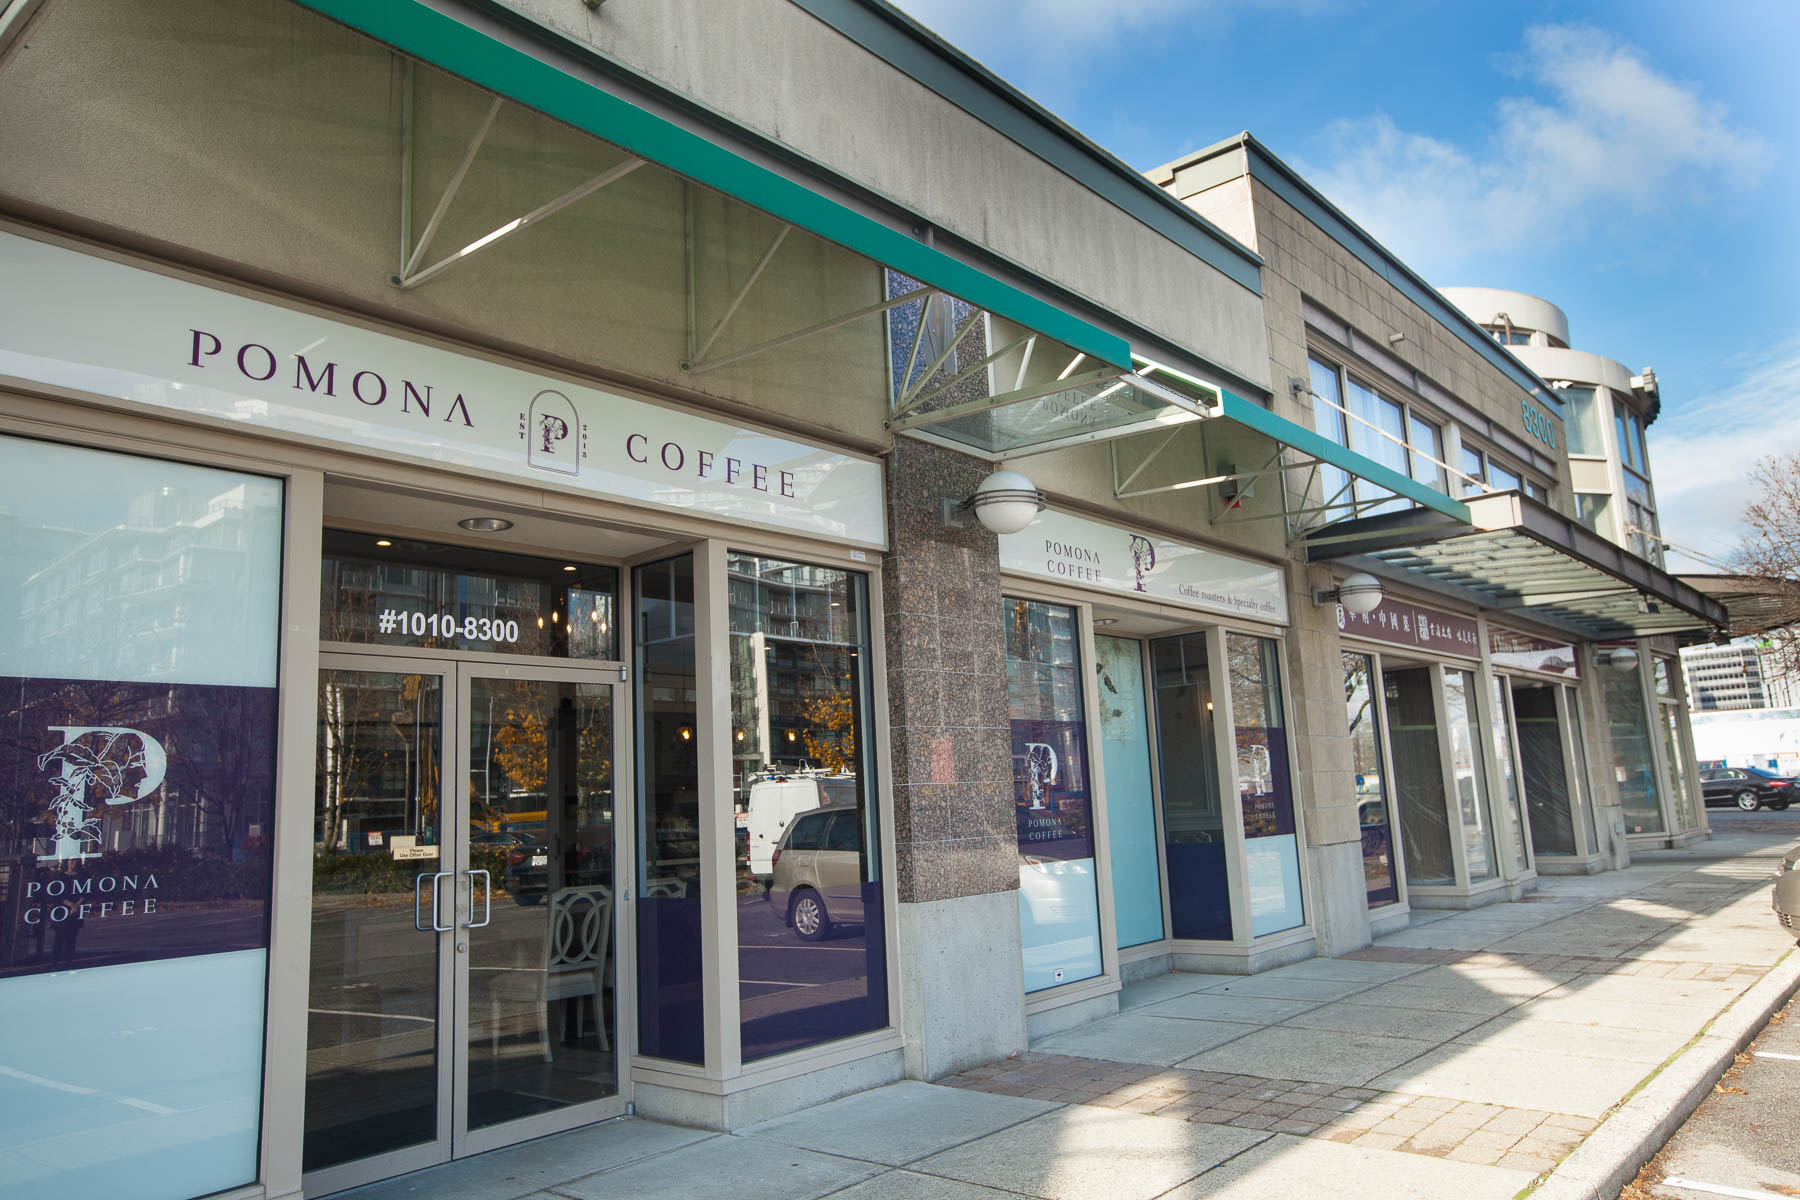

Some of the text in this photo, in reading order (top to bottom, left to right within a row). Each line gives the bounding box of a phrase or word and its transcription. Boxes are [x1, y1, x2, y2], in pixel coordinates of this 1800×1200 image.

[187, 329, 795, 498] POMONA COFFEE
[518, 413, 526, 439] EST
[1521, 400, 1556, 449] 8300
[1045, 540, 1101, 564] POMONA
[1047, 560, 1102, 583] COFFEE
[1178, 583, 1200, 599] Coffee
[1201, 591, 1226, 604] roasters
[1233, 595, 1258, 614] Specialty
[1259, 600, 1276, 613] coffee
[379, 608, 519, 643] #1010-8300
[1028, 818, 1062, 828] POMONA
[1029, 830, 1063, 841] COFFEE
[26, 874, 159, 898] POMONA
[24, 898, 157, 924] COFFEE
